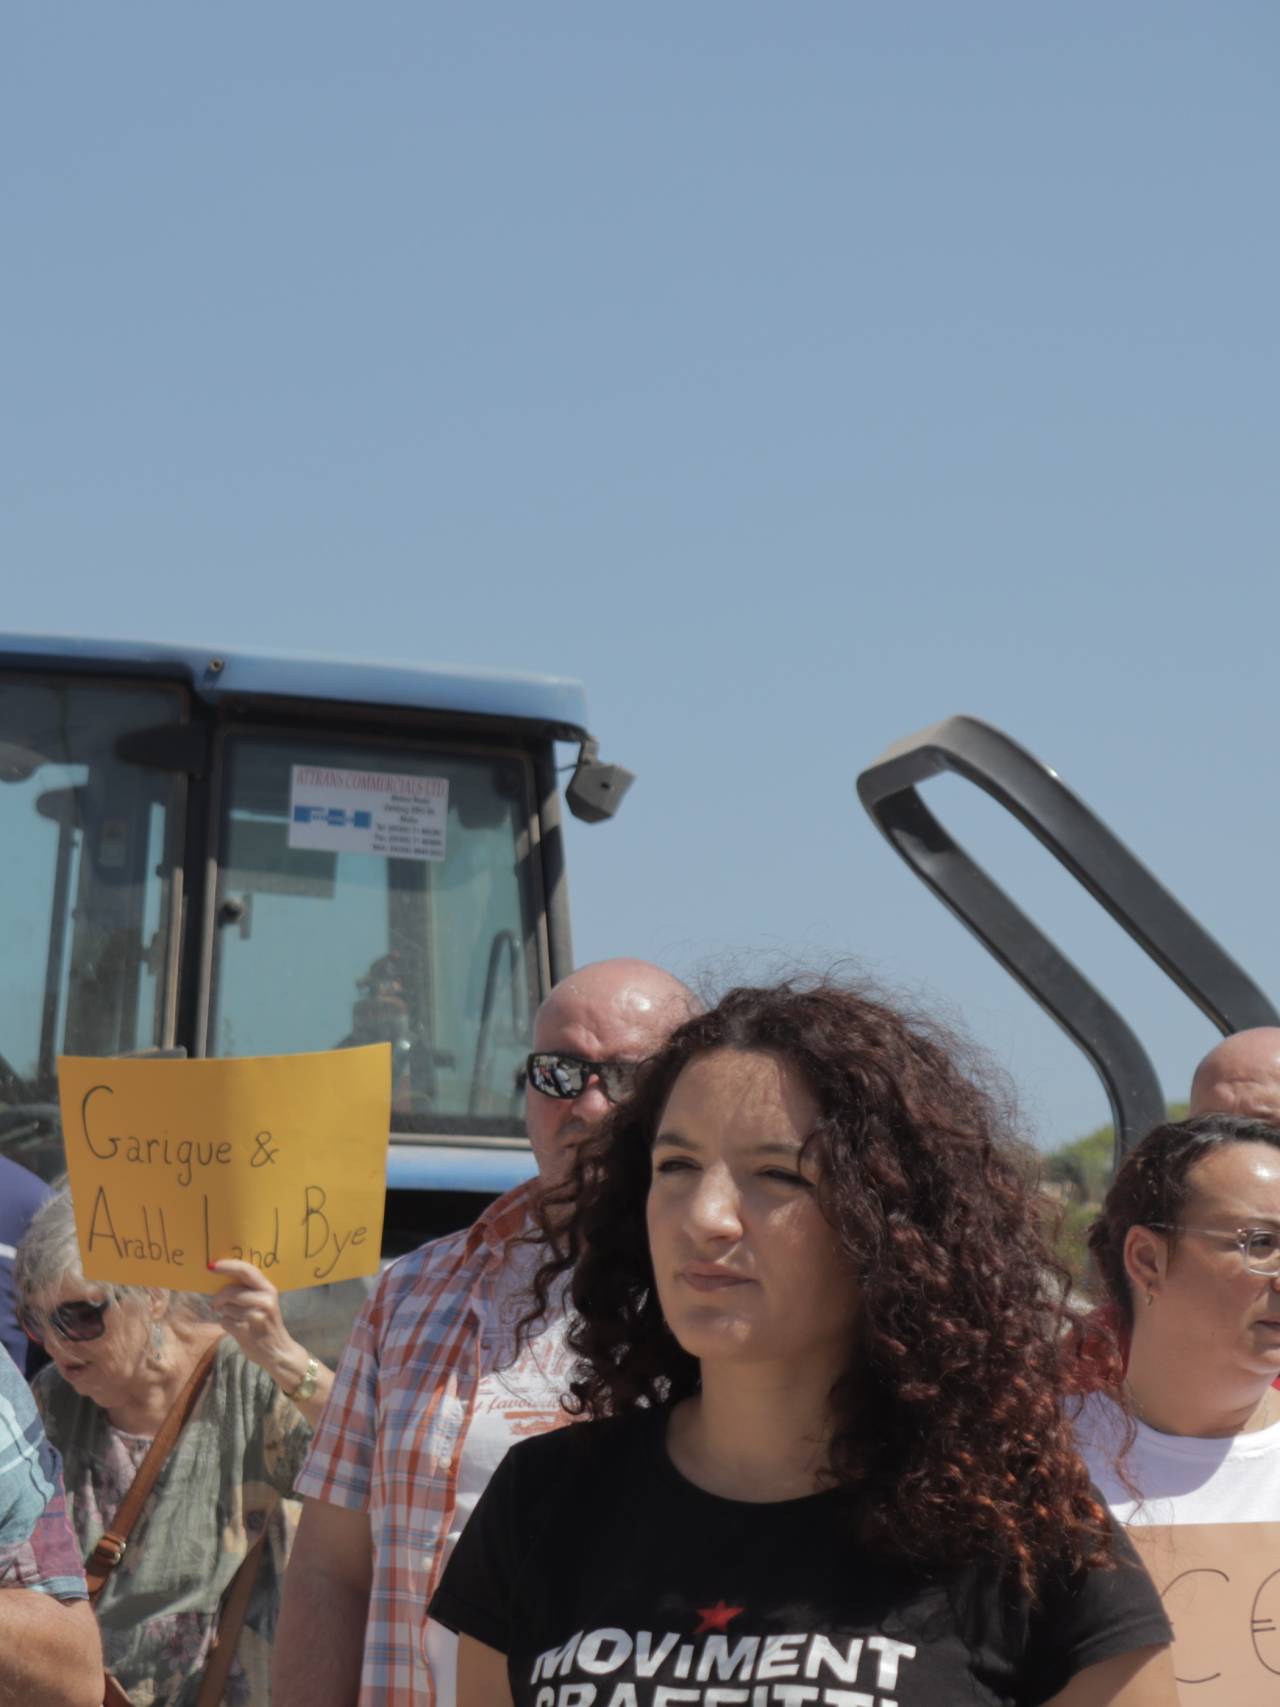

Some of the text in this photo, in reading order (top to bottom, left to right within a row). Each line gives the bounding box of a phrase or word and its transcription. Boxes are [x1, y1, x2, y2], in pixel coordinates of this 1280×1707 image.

[81, 1085, 280, 1186] Garigue &
[87, 1185, 185, 1266] Arable
[301, 1185, 368, 1279] Bye
[530, 1627, 917, 1691] MOVIMENT
